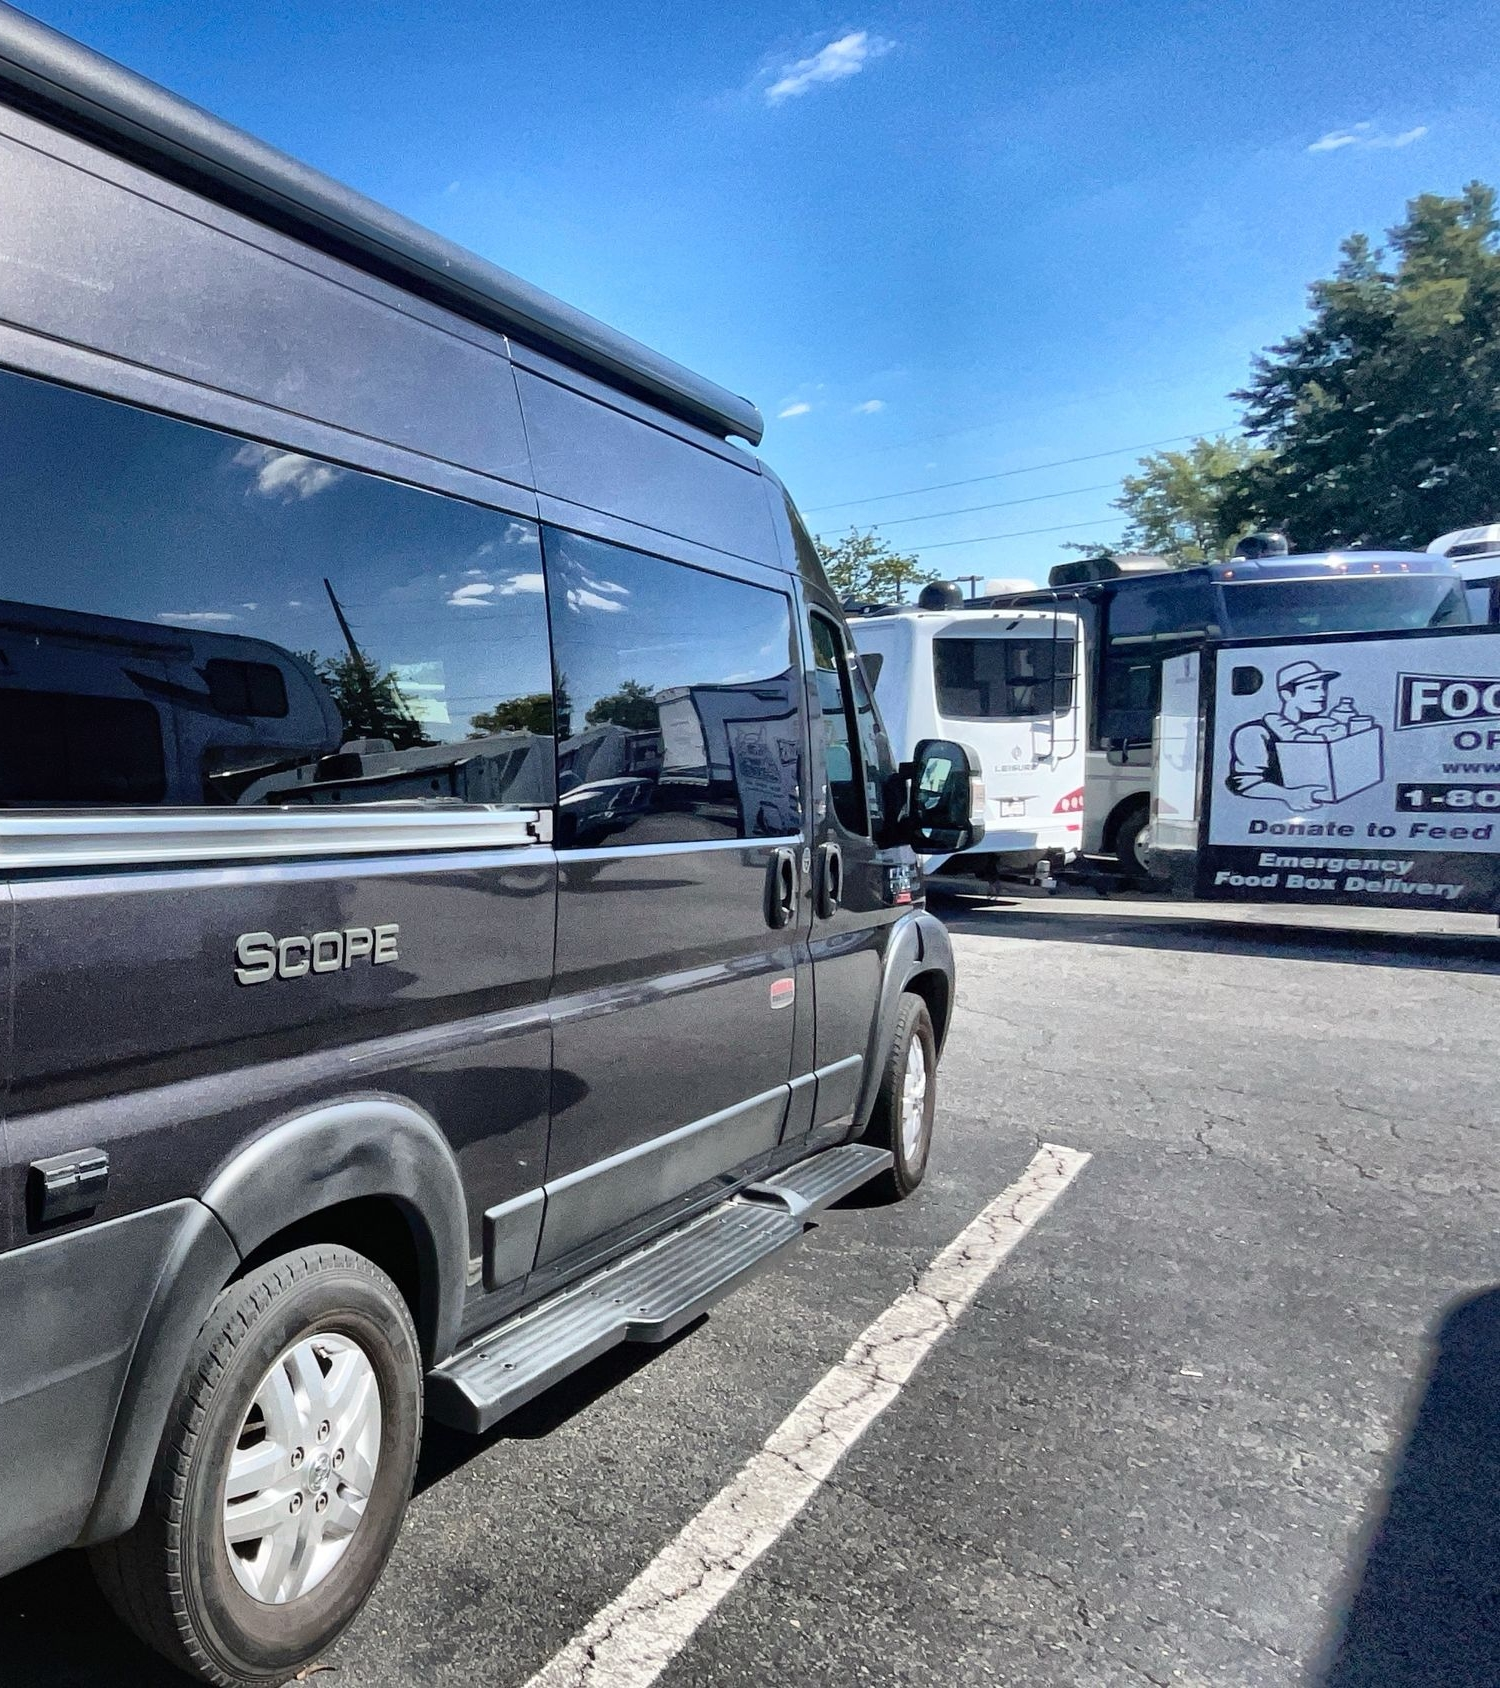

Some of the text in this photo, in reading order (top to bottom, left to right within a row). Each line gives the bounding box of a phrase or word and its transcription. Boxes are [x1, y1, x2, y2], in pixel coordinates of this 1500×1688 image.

[1248, 820, 1493, 840] Donate to Feed
[1258, 853, 1415, 876] Emergency
[1214, 871, 1464, 900] Food Box Delivery
[234, 923, 400, 986] SCOPE
